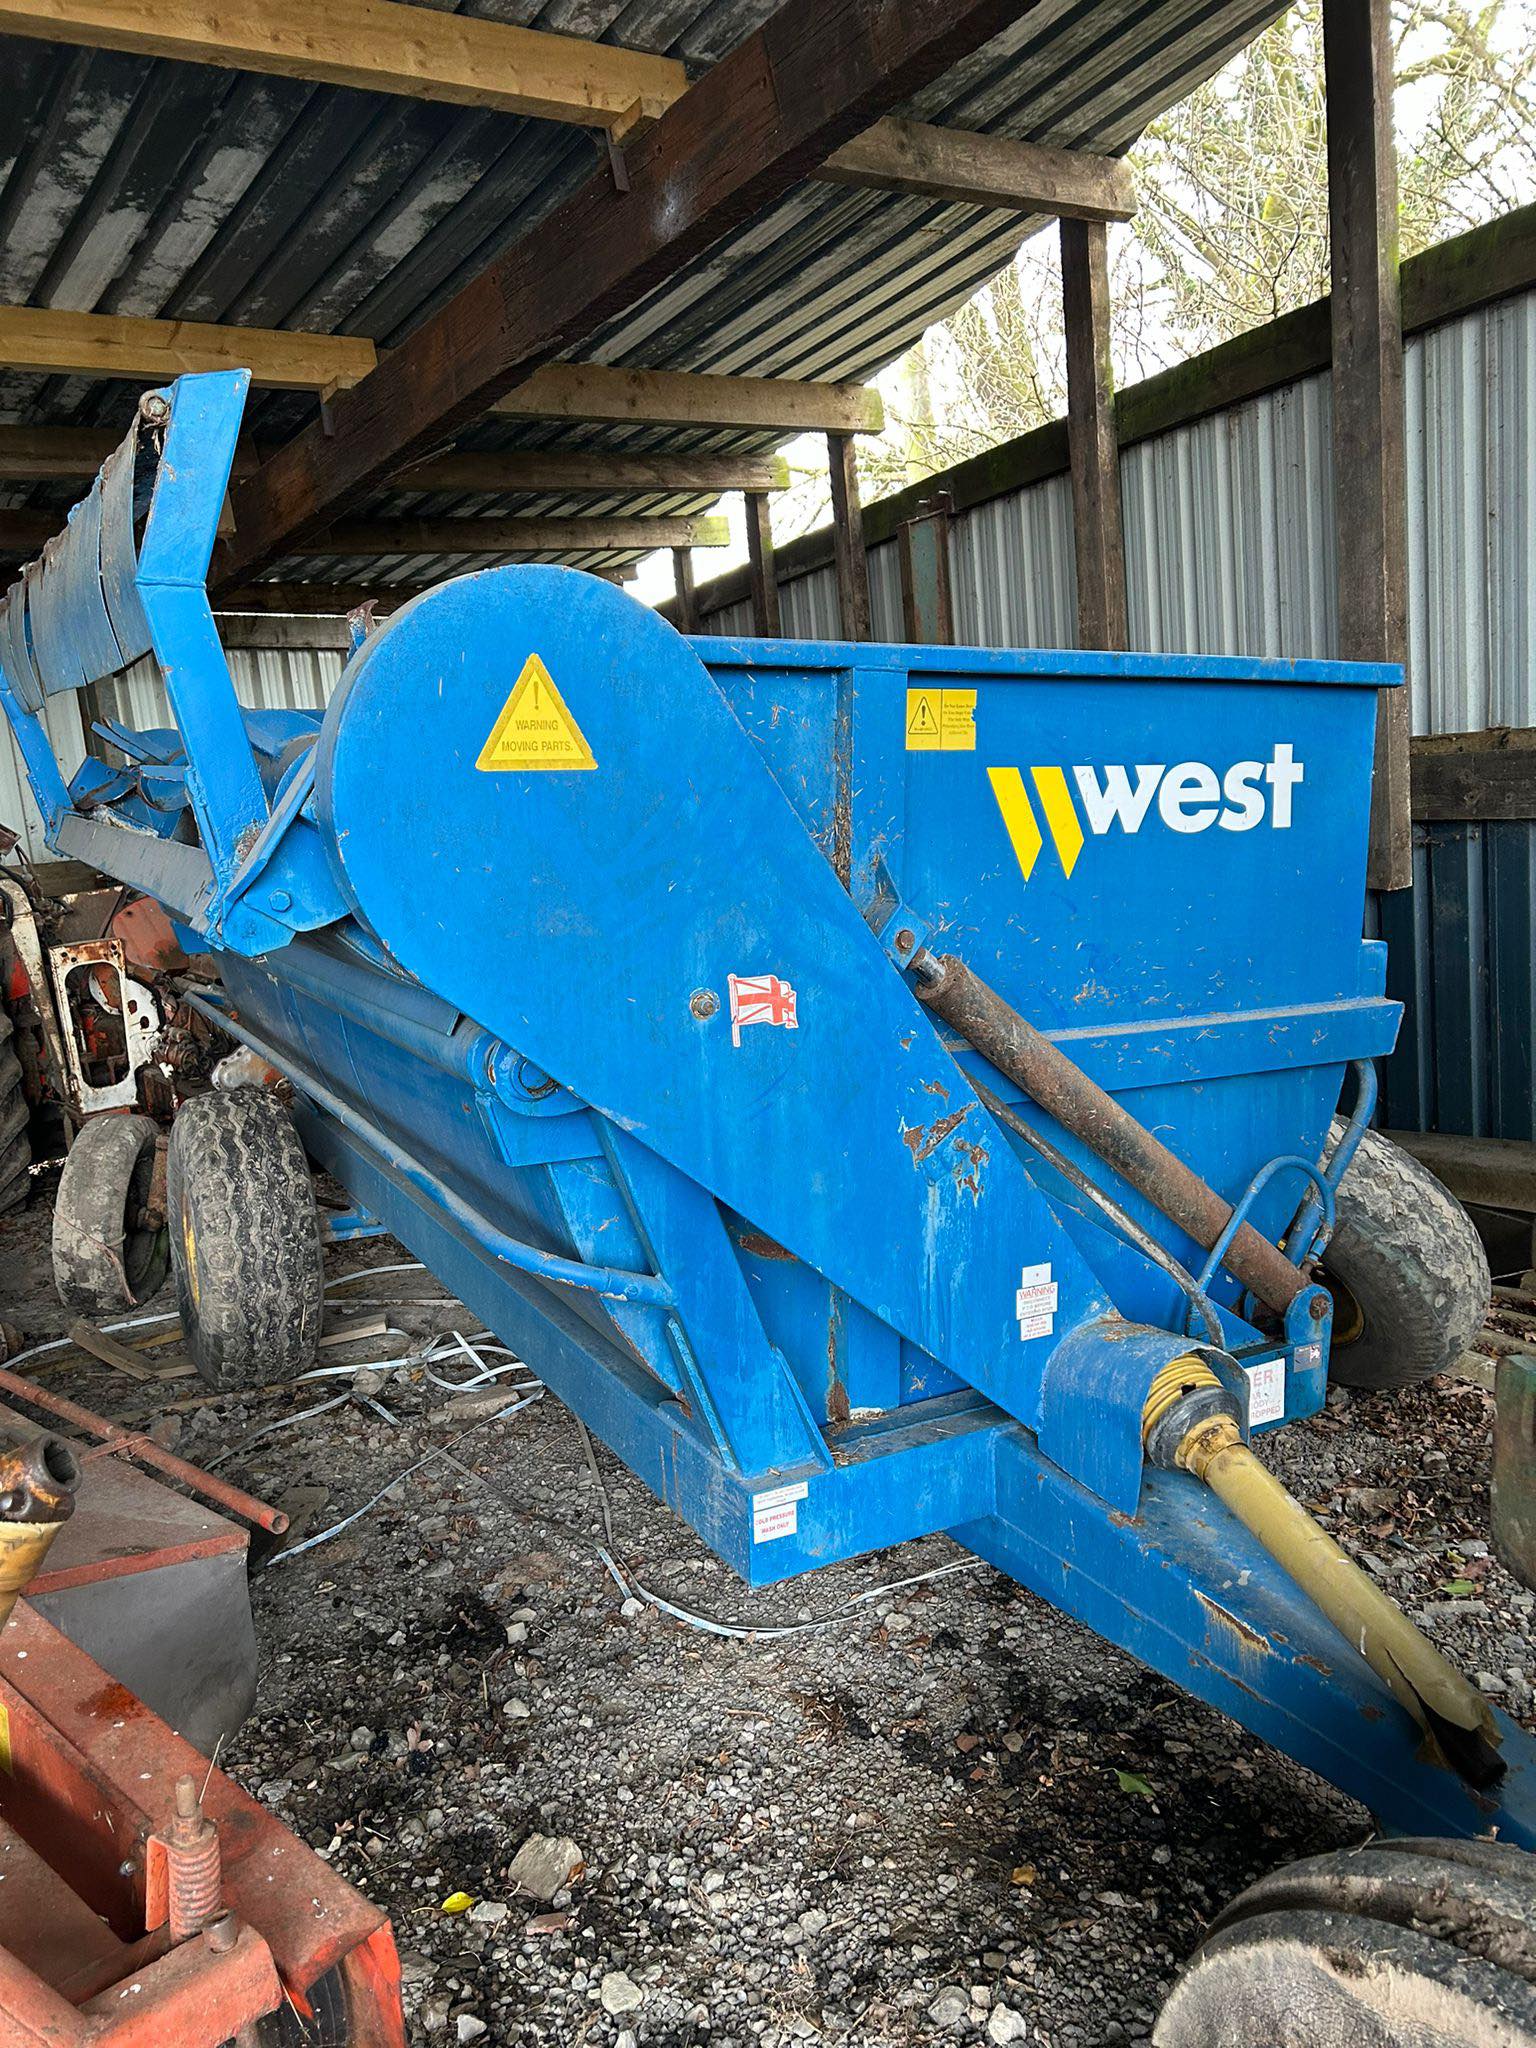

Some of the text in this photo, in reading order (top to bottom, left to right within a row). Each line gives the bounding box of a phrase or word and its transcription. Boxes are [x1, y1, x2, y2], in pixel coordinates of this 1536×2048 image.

[515, 720, 558, 731] WARNING
[501, 741, 574, 752] MOVING PARTS.
[1072, 743, 1304, 834] west
[1019, 1284, 1056, 1299] WARNING
[769, 1510, 795, 1522] PRESSURE
[761, 1521, 790, 1534] WASH ONLY
